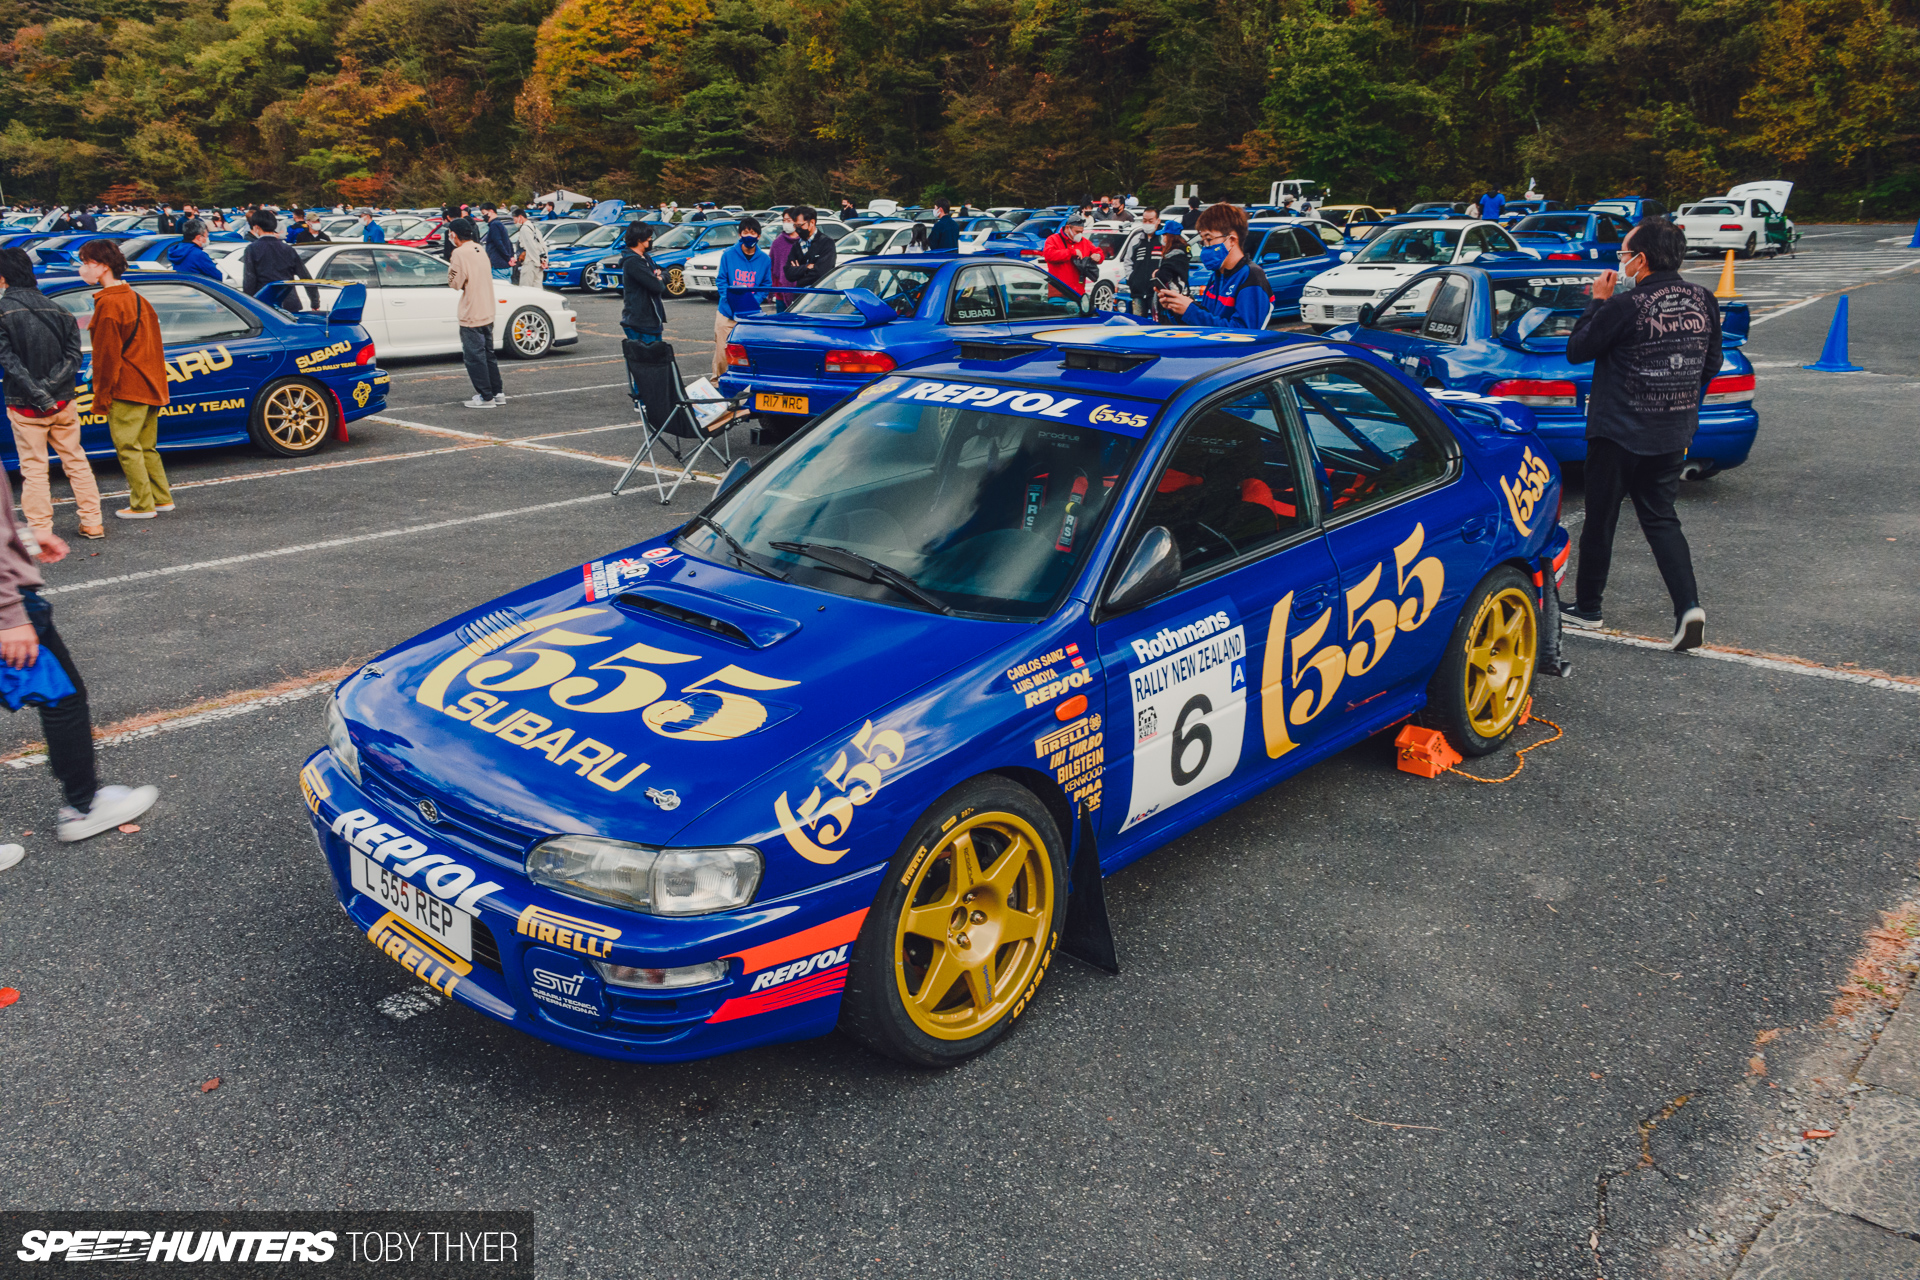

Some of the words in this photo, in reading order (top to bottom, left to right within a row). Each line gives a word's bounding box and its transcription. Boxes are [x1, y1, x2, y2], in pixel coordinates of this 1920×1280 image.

[734, 268, 757, 283] CHECK
[1527, 276, 1603, 287] SUBA
[958, 308, 996, 319] SUBARU
[1429, 321, 1458, 335] SUBARU
[1644, 311, 1706, 340] Norton
[295, 339, 352, 369] SUBARU
[299, 366, 323, 374] WORLD
[322, 363, 340, 371] RALLY
[340, 361, 357, 369] TEAM
[157, 401, 196, 418] ALLY
[199, 398, 245, 412] TEAM
[763, 395, 779, 408] R17
[782, 396, 803, 410] WRC
[897, 382, 1083, 418] REPSOL
[1064, 513, 1075, 537] RS
[1131, 610, 1231, 664] Rothmans
[1007, 658, 1043, 681] CARLOS
[1040, 647, 1066, 668] SAINZ
[1134, 659, 1170, 703] RALLY
[1171, 650, 1198, 686] NEW
[1199, 633, 1242, 675] ZEALAND
[1232, 664, 1245, 687] A
[1012, 675, 1034, 695] LUIS
[1033, 668, 1059, 687] MOYA
[1024, 667, 1094, 710] REPSOL
[443, 690, 651, 792] SUBARU
[1034, 716, 1090, 759] PIRELLI
[1049, 751, 1066, 770] IHI
[1068, 731, 1104, 761] TURBO
[1170, 693, 1213, 787] 6
[1057, 747, 1105, 785] BILSTEIN
[1064, 765, 1103, 793] KENWOOD
[1073, 778, 1103, 803] PIAA
[1077, 789, 1103, 819] GK
[1126, 803, 1160, 827] Mobil
[331, 808, 505, 918] REPSOL
[364, 858, 376, 893] L
[380, 868, 410, 913] 555
[415, 885, 453, 938] REP
[516, 903, 623, 959] PIRELLI
[367, 910, 473, 998] PIRELLI
[749, 944, 849, 993] REPSOL
[530, 986, 562, 1002] SUBARU
[562, 996, 598, 1012] TECNICA
[532, 992, 600, 1017] INTERNATIONAL
